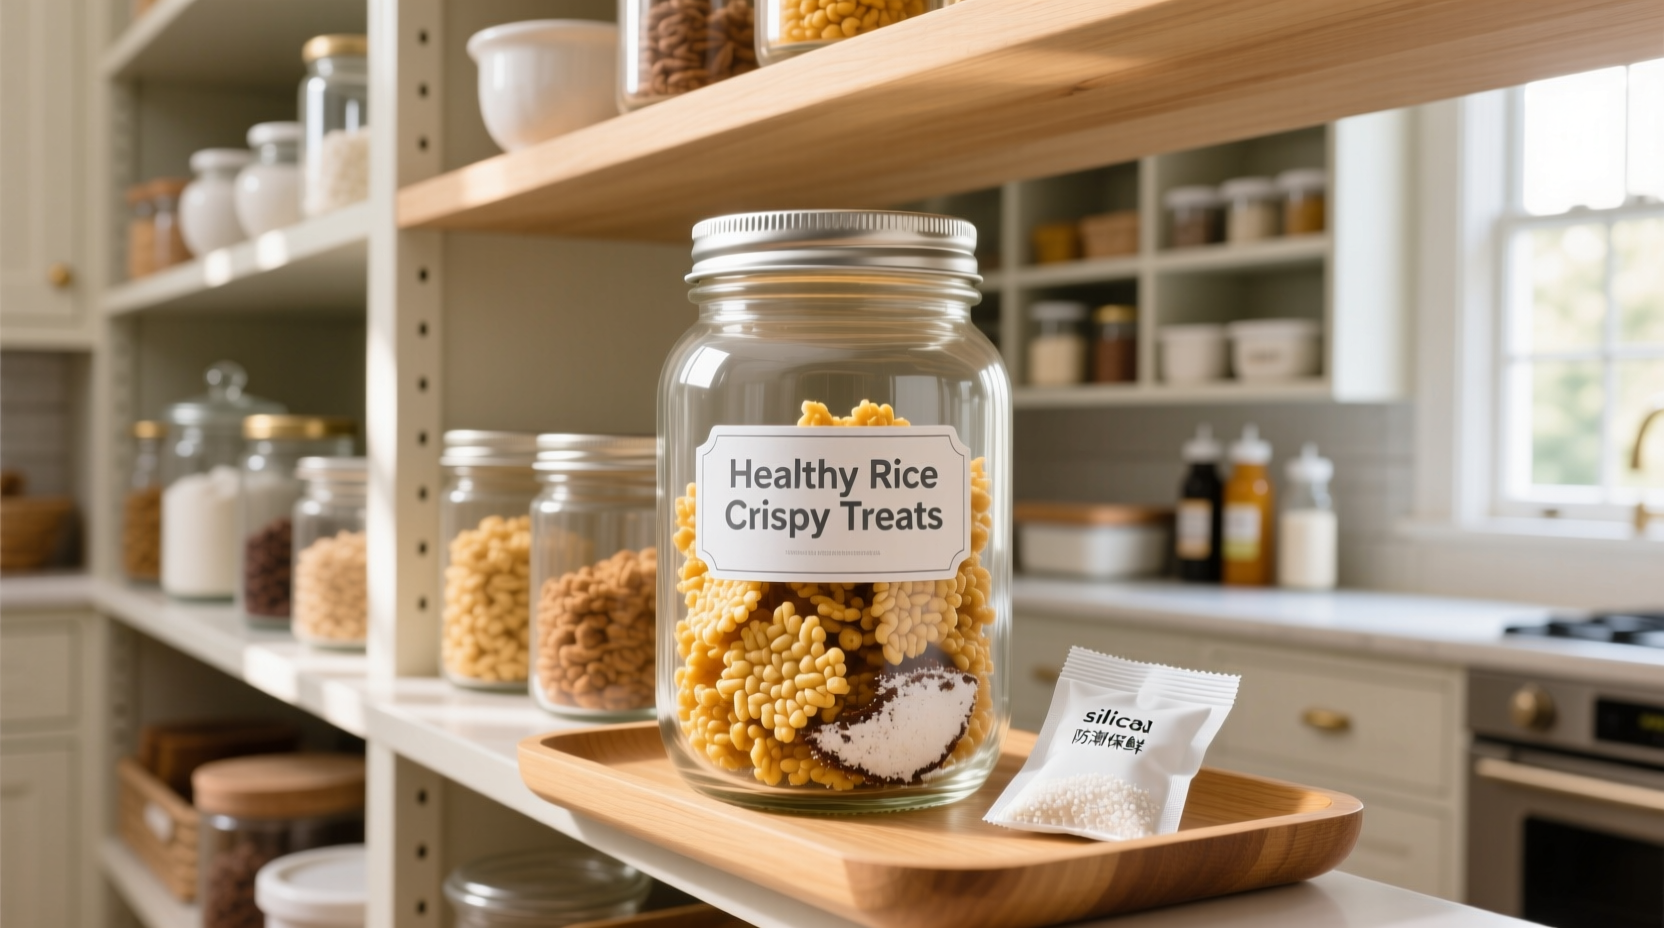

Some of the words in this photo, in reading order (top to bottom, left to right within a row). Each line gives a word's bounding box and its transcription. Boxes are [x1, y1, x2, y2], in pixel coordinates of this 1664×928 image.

[730, 458, 859, 497] Healthy
[870, 458, 938, 489] Rice
[725, 499, 831, 539] Crispy
[840, 500, 943, 531] Treats
